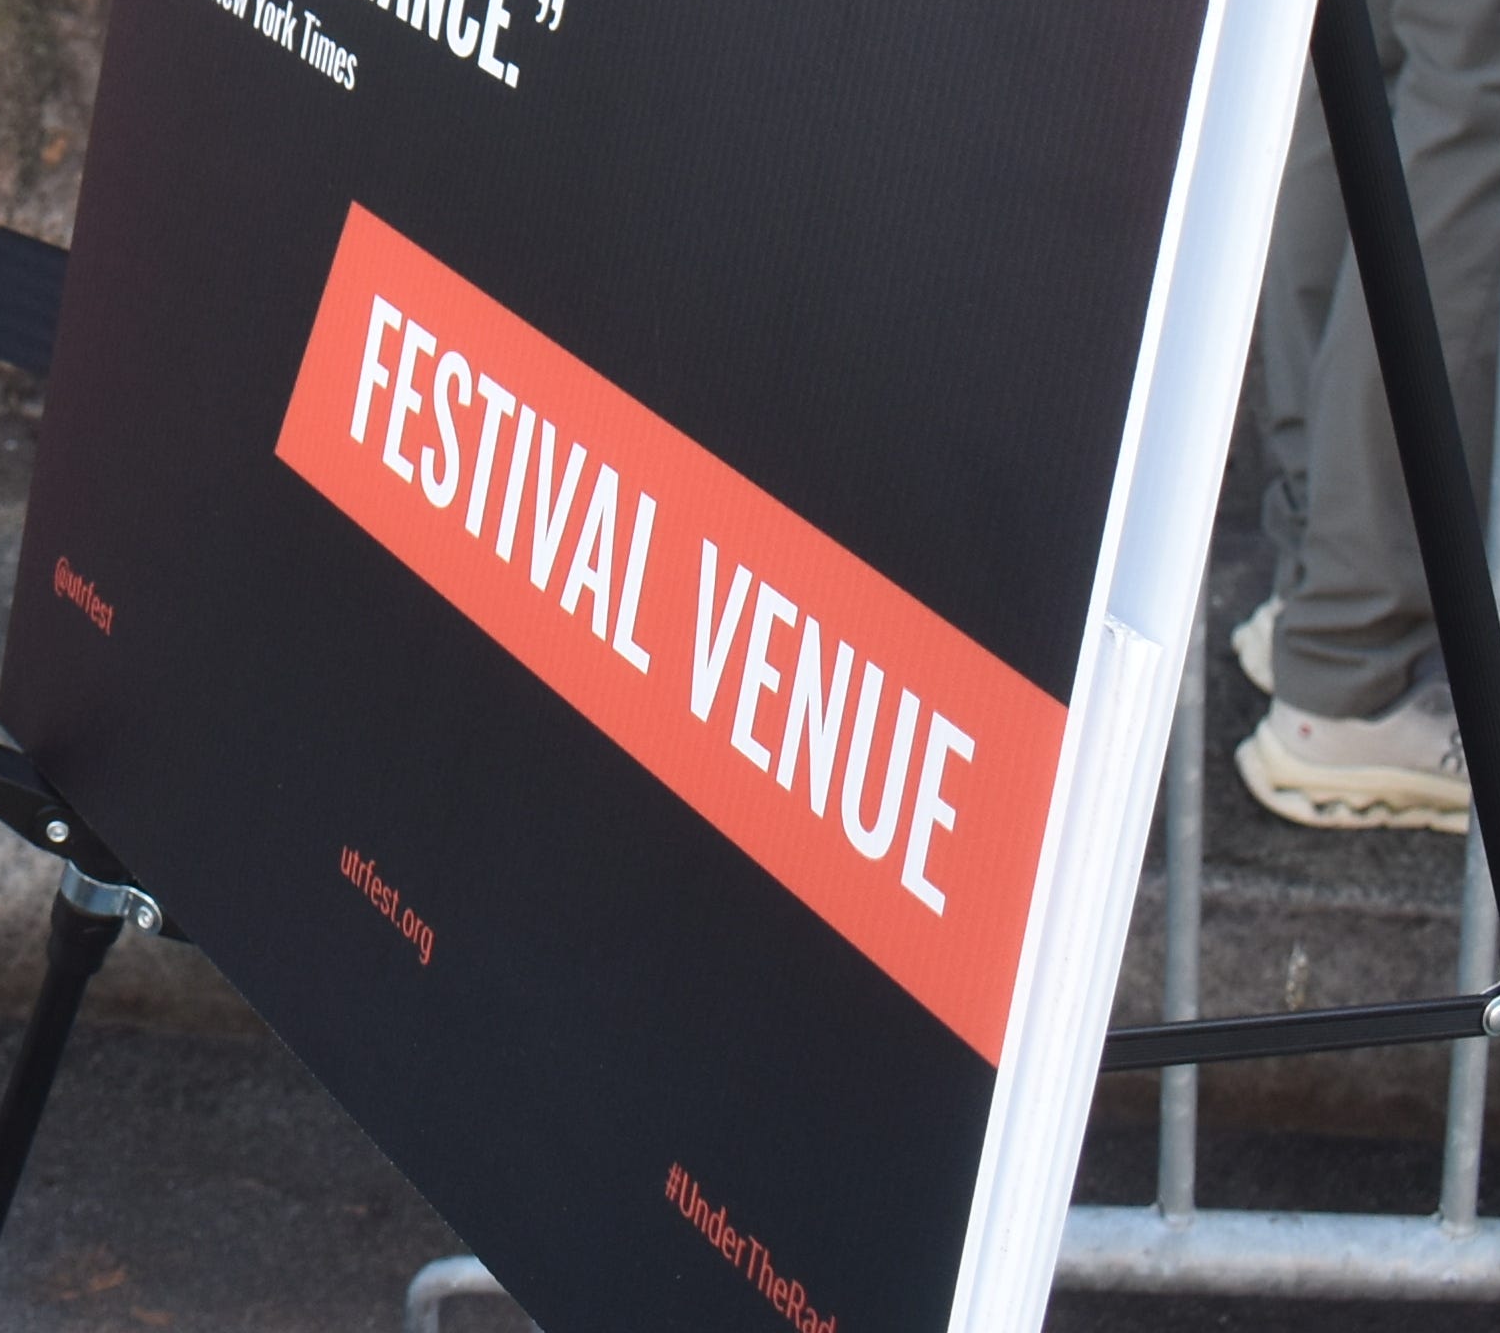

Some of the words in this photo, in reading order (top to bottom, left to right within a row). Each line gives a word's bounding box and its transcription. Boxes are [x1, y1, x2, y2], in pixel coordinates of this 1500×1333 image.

[300, 9, 358, 91] Times
[54, 555, 115, 637] @utrfest
[349, 293, 657, 675] FESTIVAL
[687, 537, 976, 918] VENUE
[340, 844, 435, 966] utrfest.org
